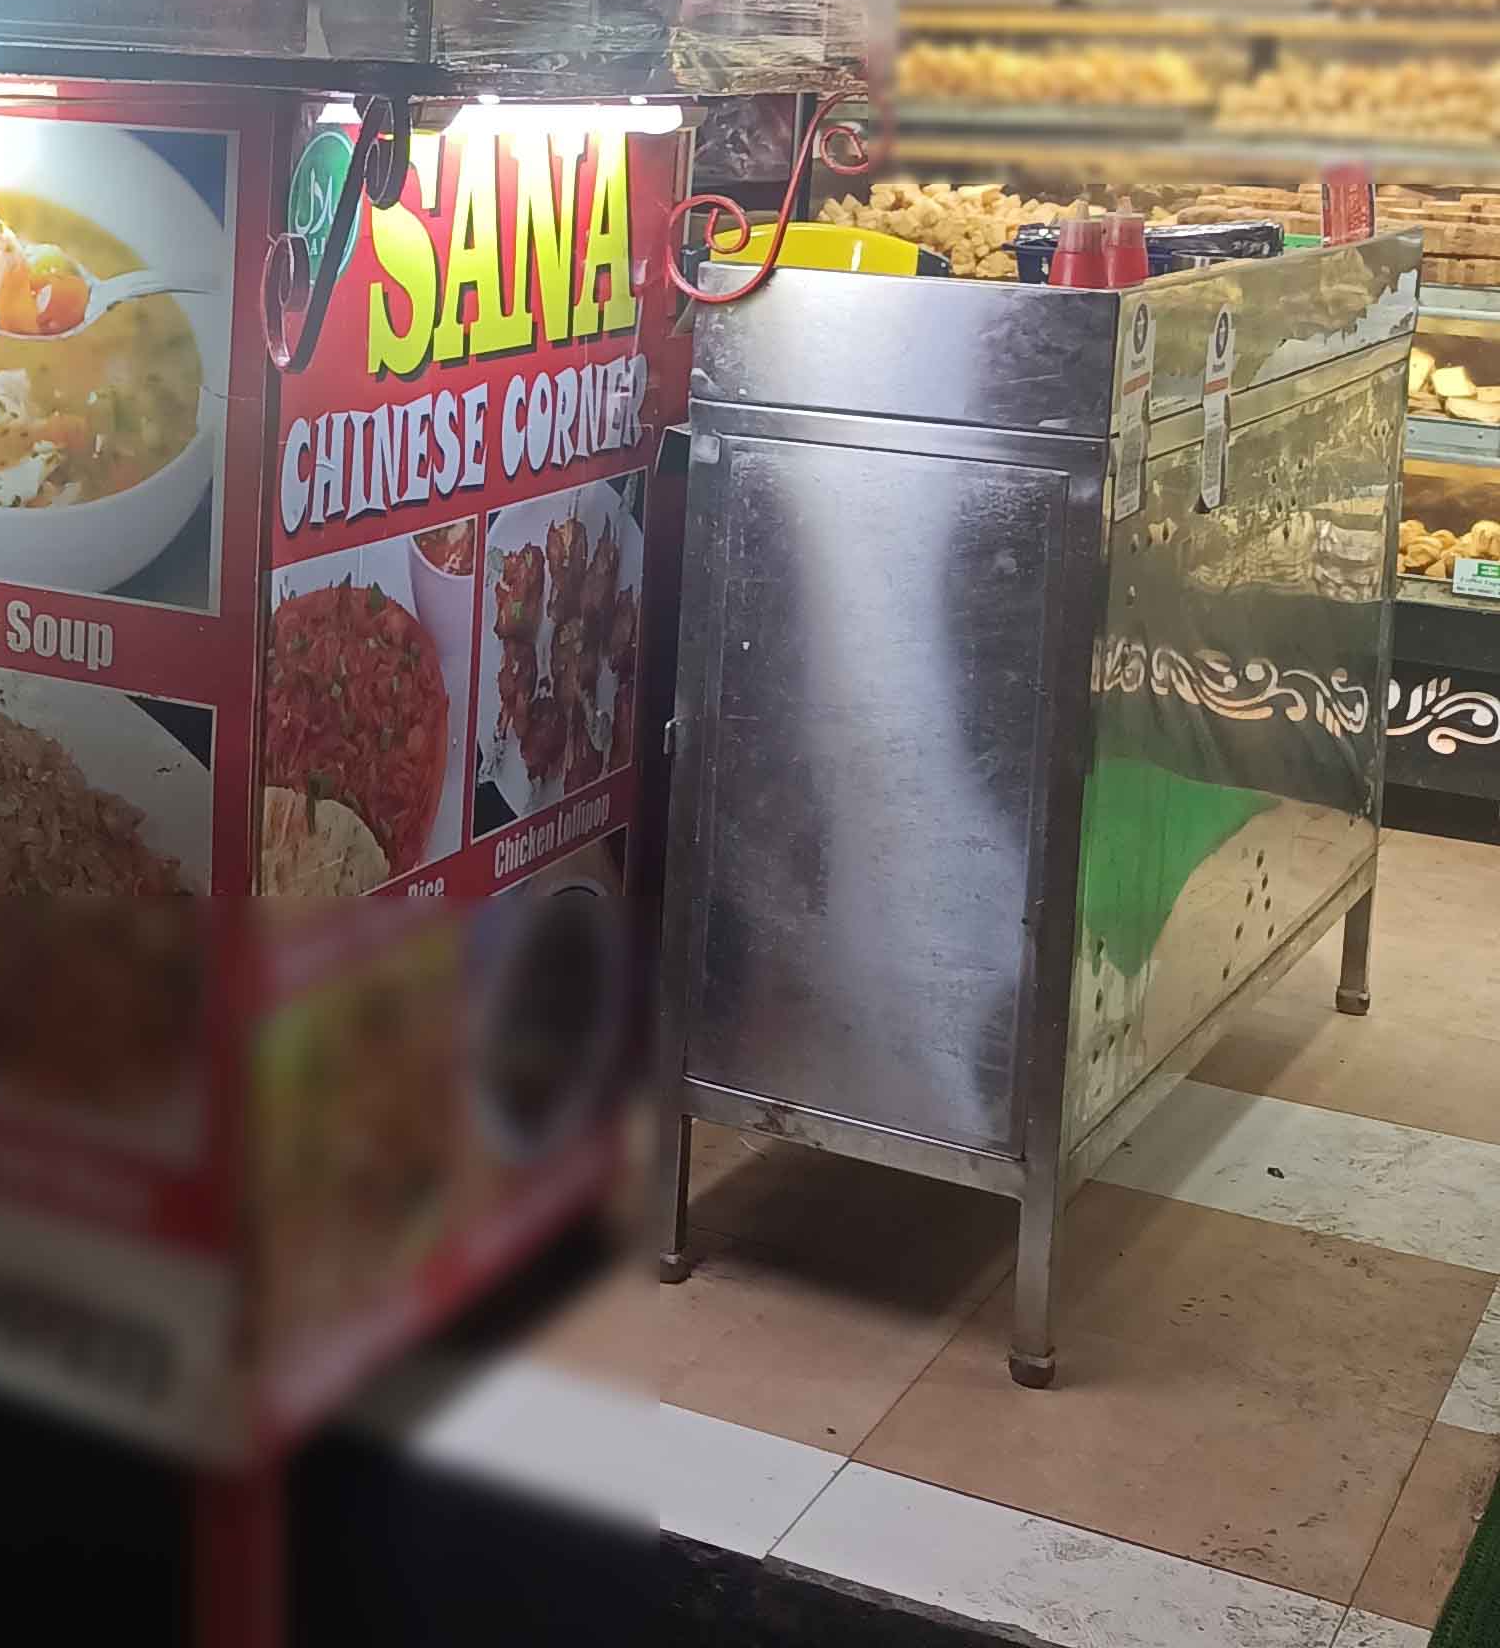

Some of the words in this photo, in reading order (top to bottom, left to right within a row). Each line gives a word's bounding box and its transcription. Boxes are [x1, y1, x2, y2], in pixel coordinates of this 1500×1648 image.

[367, 129, 636, 375] SANA
[280, 383, 488, 533] CHINESE
[501, 353, 648, 477] CORNER
[6, 600, 114, 671] Soup
[494, 821, 555, 879] Chicken
[556, 793, 611, 847] Lollipop
